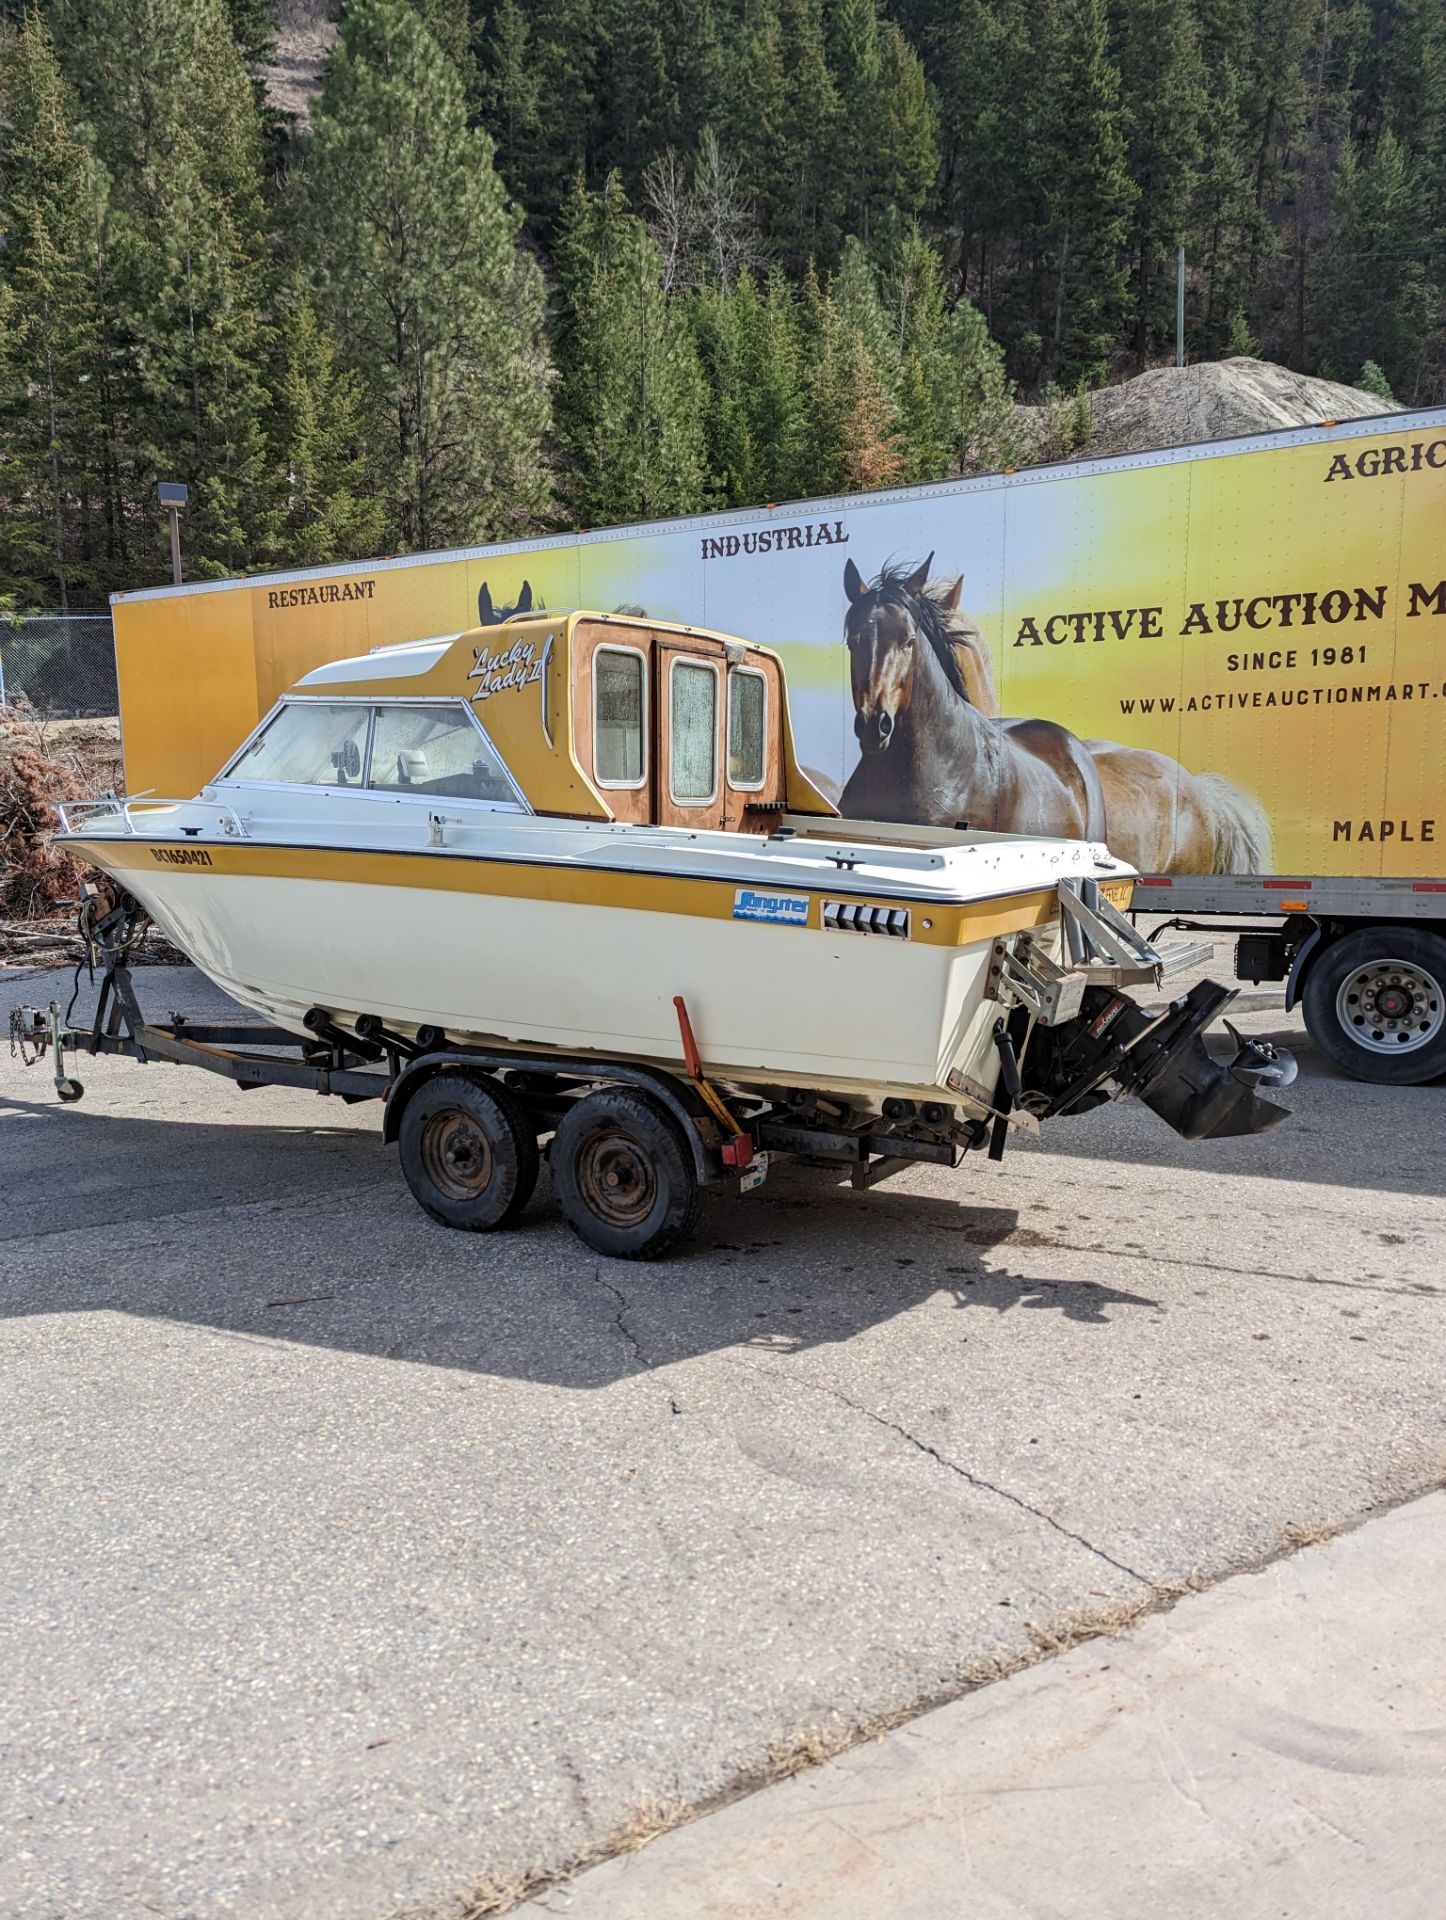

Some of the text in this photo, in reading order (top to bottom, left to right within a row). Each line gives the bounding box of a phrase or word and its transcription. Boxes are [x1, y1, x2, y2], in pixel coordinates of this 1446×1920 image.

[1323, 440, 1446, 482] AGRIC
[701, 521, 850, 560] INDUSTRIAL
[268, 581, 376, 609] RESTAURANT
[1013, 607, 1163, 647] ACTIVE
[1179, 586, 1388, 636] AUCTION
[1227, 645, 1366, 672] SINCE 1981
[469, 662, 527, 703] Lady
[1120, 681, 1446, 714] WWW.ACTIVEAUCTIONMART.
[1332, 820, 1435, 842] MAPLE
[734, 891, 810, 914] Sangster
